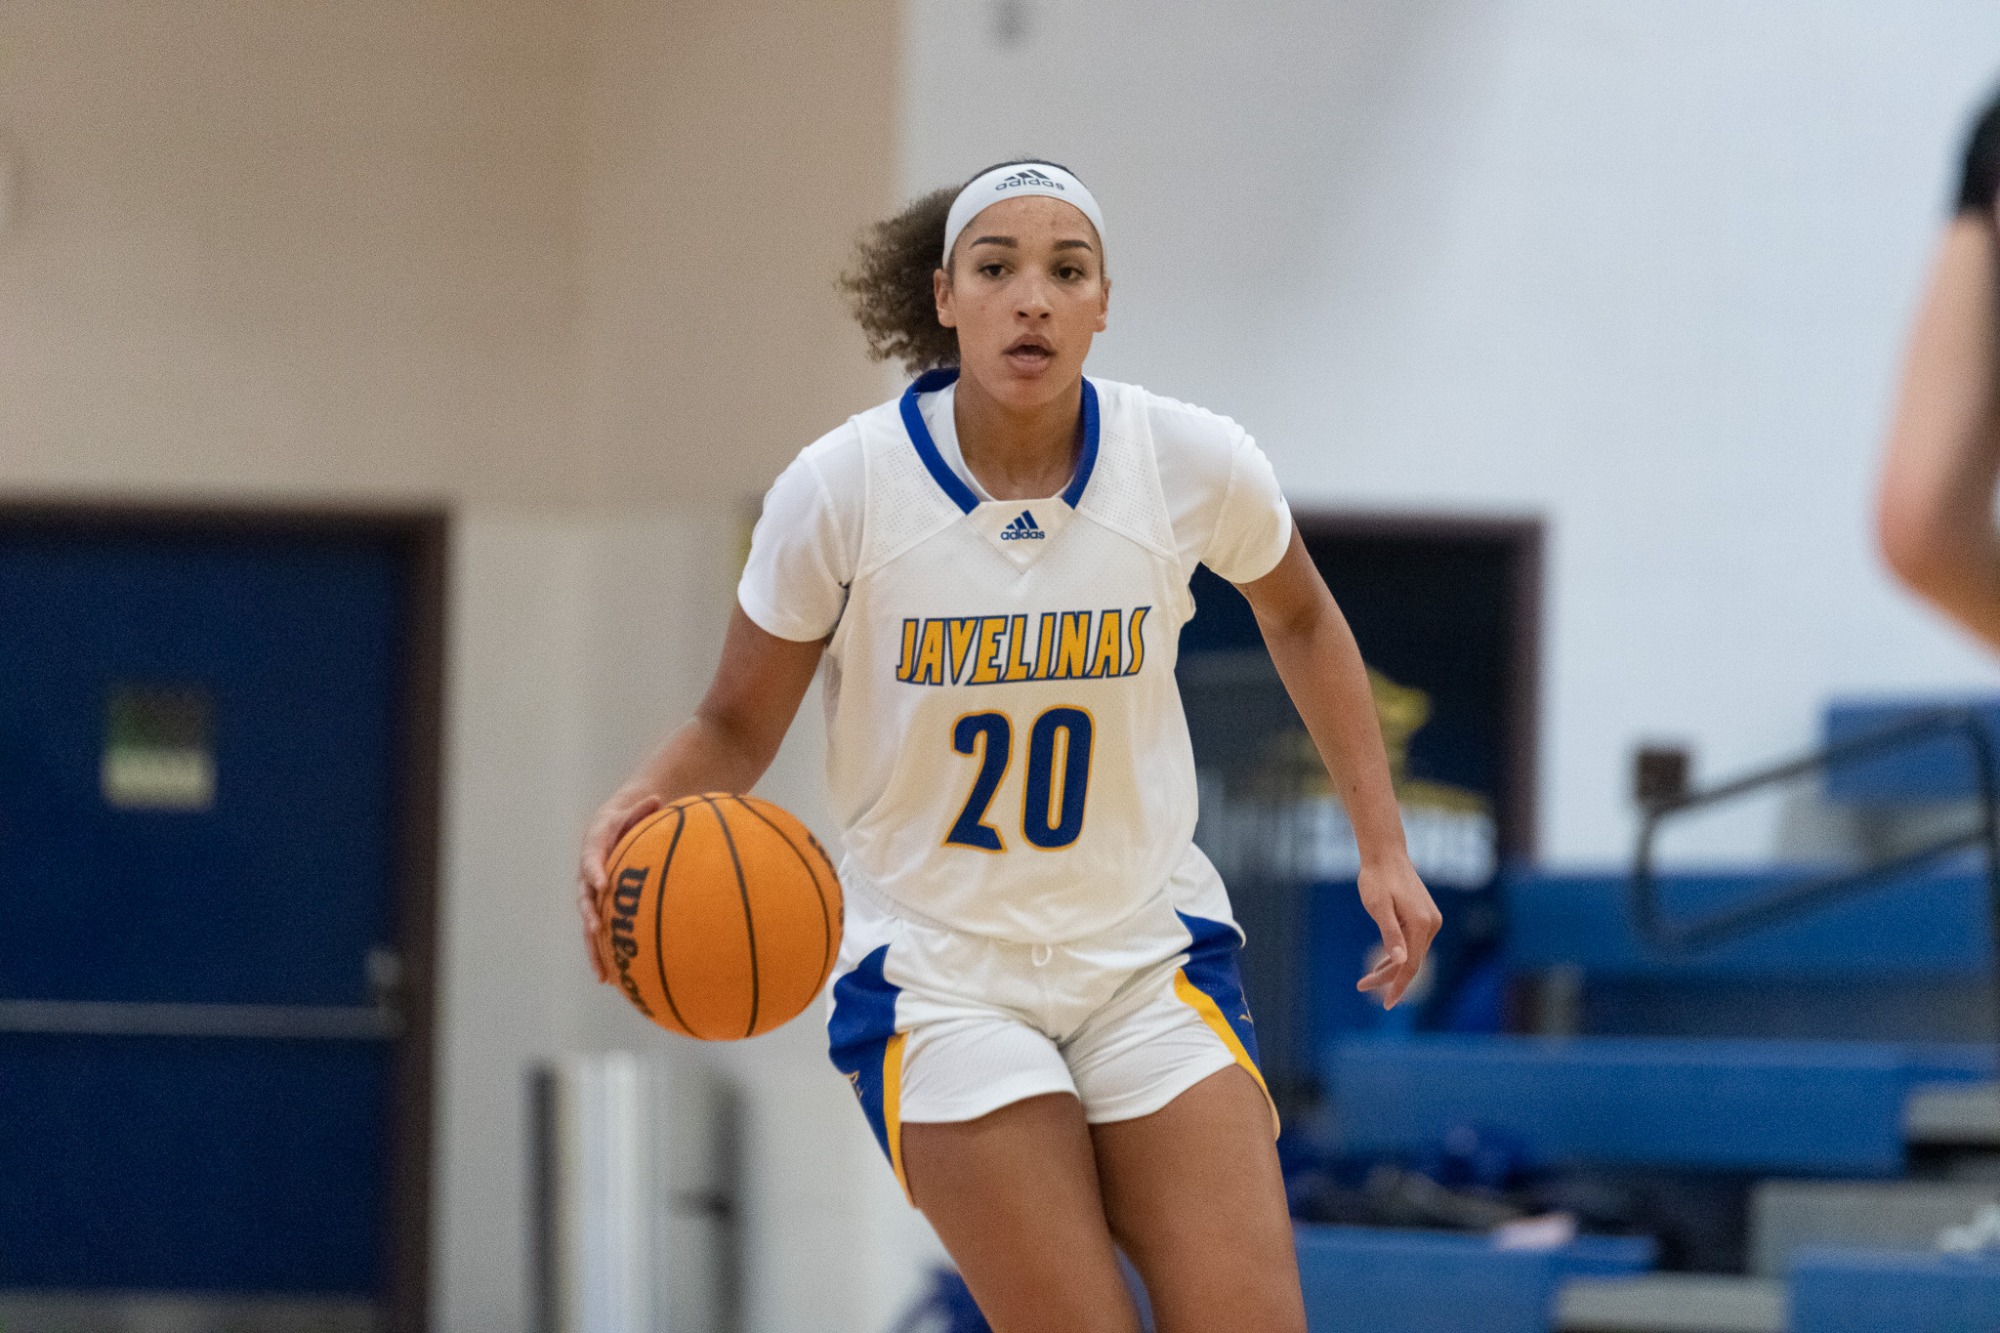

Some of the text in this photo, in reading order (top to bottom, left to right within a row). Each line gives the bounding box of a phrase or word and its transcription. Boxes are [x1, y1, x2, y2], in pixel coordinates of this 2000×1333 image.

[995, 177, 1065, 191] adidas
[1000, 528, 1045, 540] adidas
[895, 605, 1152, 686] JAVELINAS
[941, 703, 1096, 854] 20
